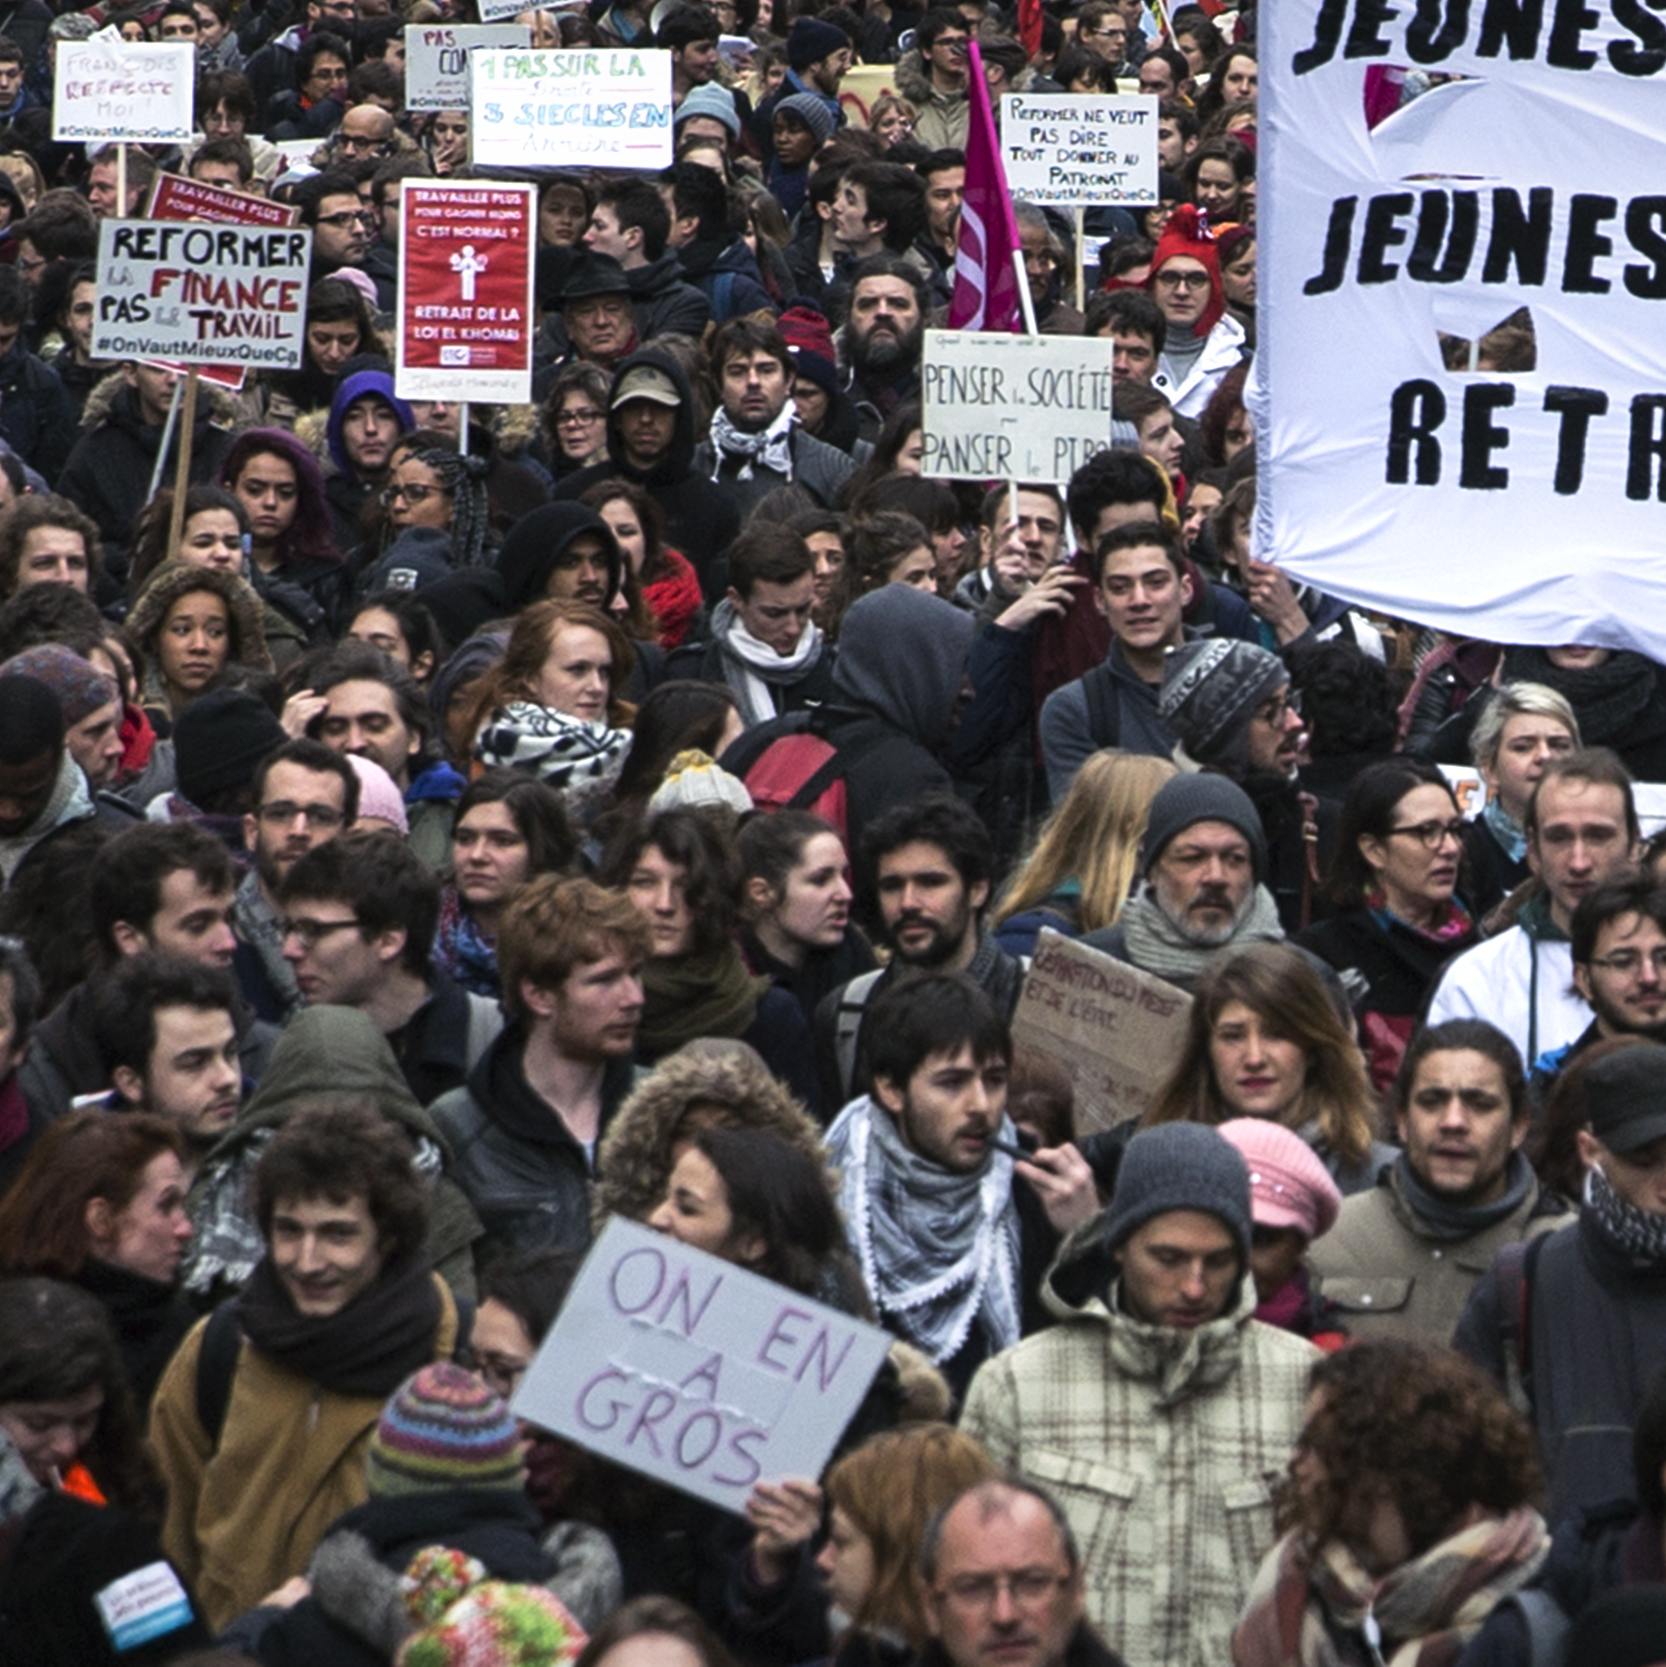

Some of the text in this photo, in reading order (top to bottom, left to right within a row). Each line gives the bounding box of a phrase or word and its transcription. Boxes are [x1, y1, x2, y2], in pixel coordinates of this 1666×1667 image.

[423, 30, 457, 48] PAS
[480, 53, 646, 80] 1 PAS SUR LA
[483, 102, 504, 124] 3
[628, 102, 671, 129] EN
[1009, 97, 1150, 126] REFORMER NE VEUT
[1030, 127, 1060, 145] PAS
[1009, 146, 1140, 167] TOUT DONNER AU
[1049, 166, 1129, 186] PATRONAT
[166, 198, 196, 213] POUR
[171, 180, 282, 224] TRAVAILLER PLUS
[414, 190, 523, 206] TRAVAILLER PLUS
[414, 207, 443, 219] POUR
[444, 207, 487, 221] GAGNER
[416, 225, 521, 240] C'EST NORMAL ?
[113, 227, 307, 268] REFORMER
[107, 265, 303, 313] LA FINANCE
[99, 293, 151, 324] PAS
[414, 305, 521, 322] RETRAIT DE LA
[414, 326, 520, 343] LOI EL KHOMRI
[924, 363, 1009, 407] PENSER
[1027, 363, 1111, 412] SOCIÉTÉ
[922, 433, 1041, 477] PANSER le
[608, 1247, 859, 1395] ON EN
[680, 1352, 724, 1403] A
[574, 1368, 770, 1487] GROS
